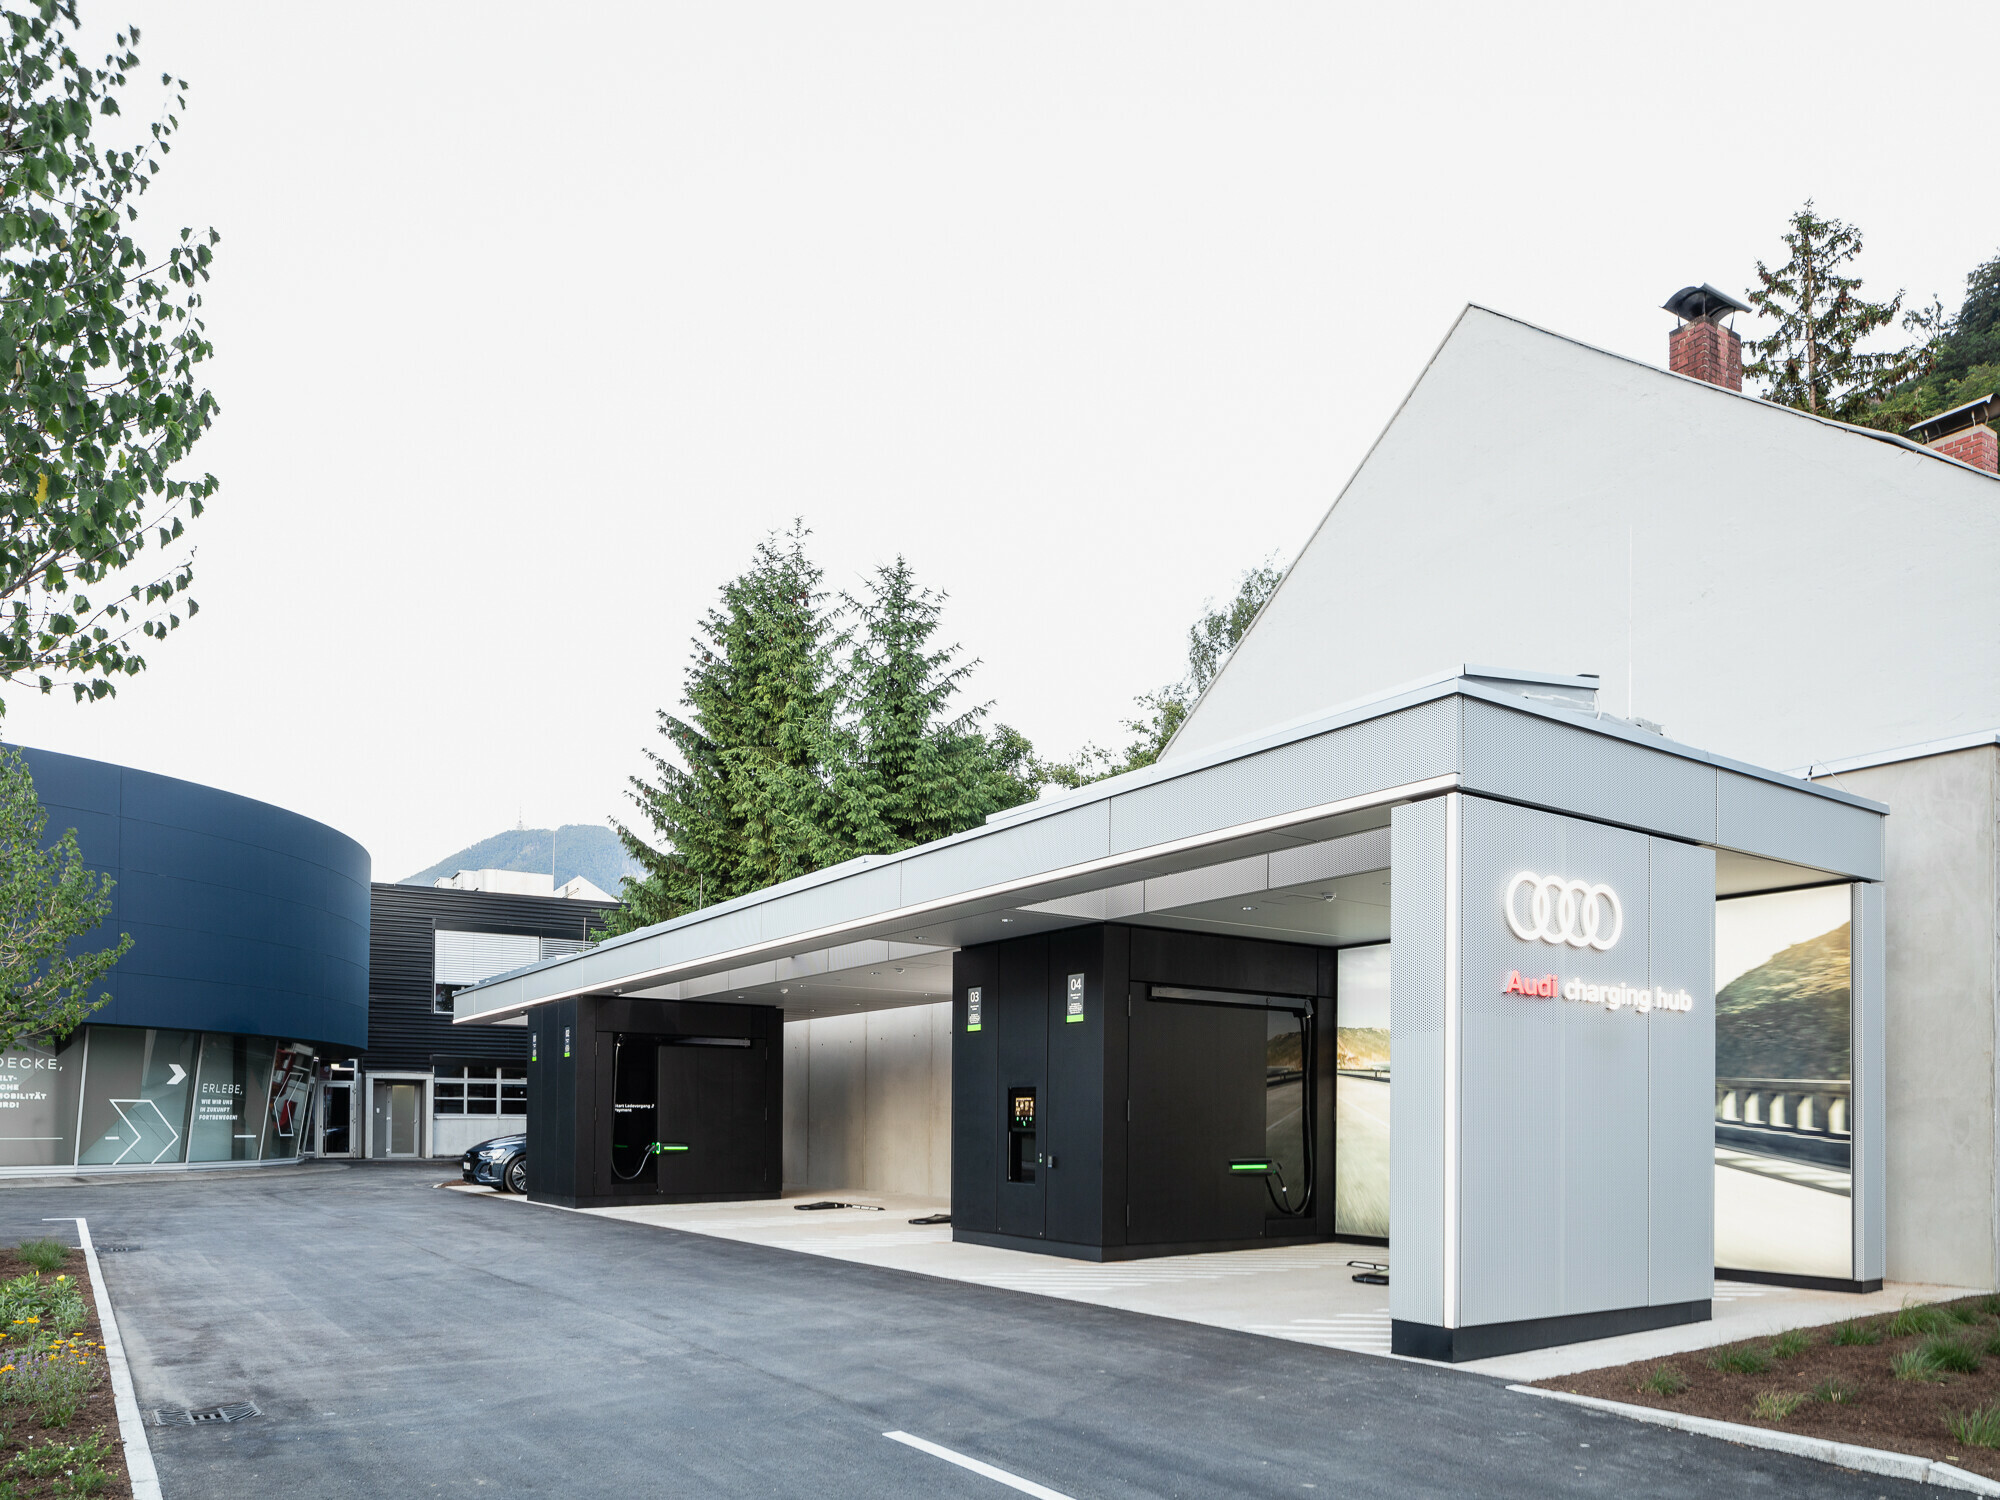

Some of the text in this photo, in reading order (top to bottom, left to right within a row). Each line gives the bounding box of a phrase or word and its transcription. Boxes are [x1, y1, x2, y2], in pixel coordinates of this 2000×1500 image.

[1070, 978, 1082, 991] 04
[1506, 969, 1693, 1013] Audi charging hub
[970, 991, 980, 1003] 03
[202, 1083, 243, 1096] ERLEBE,
